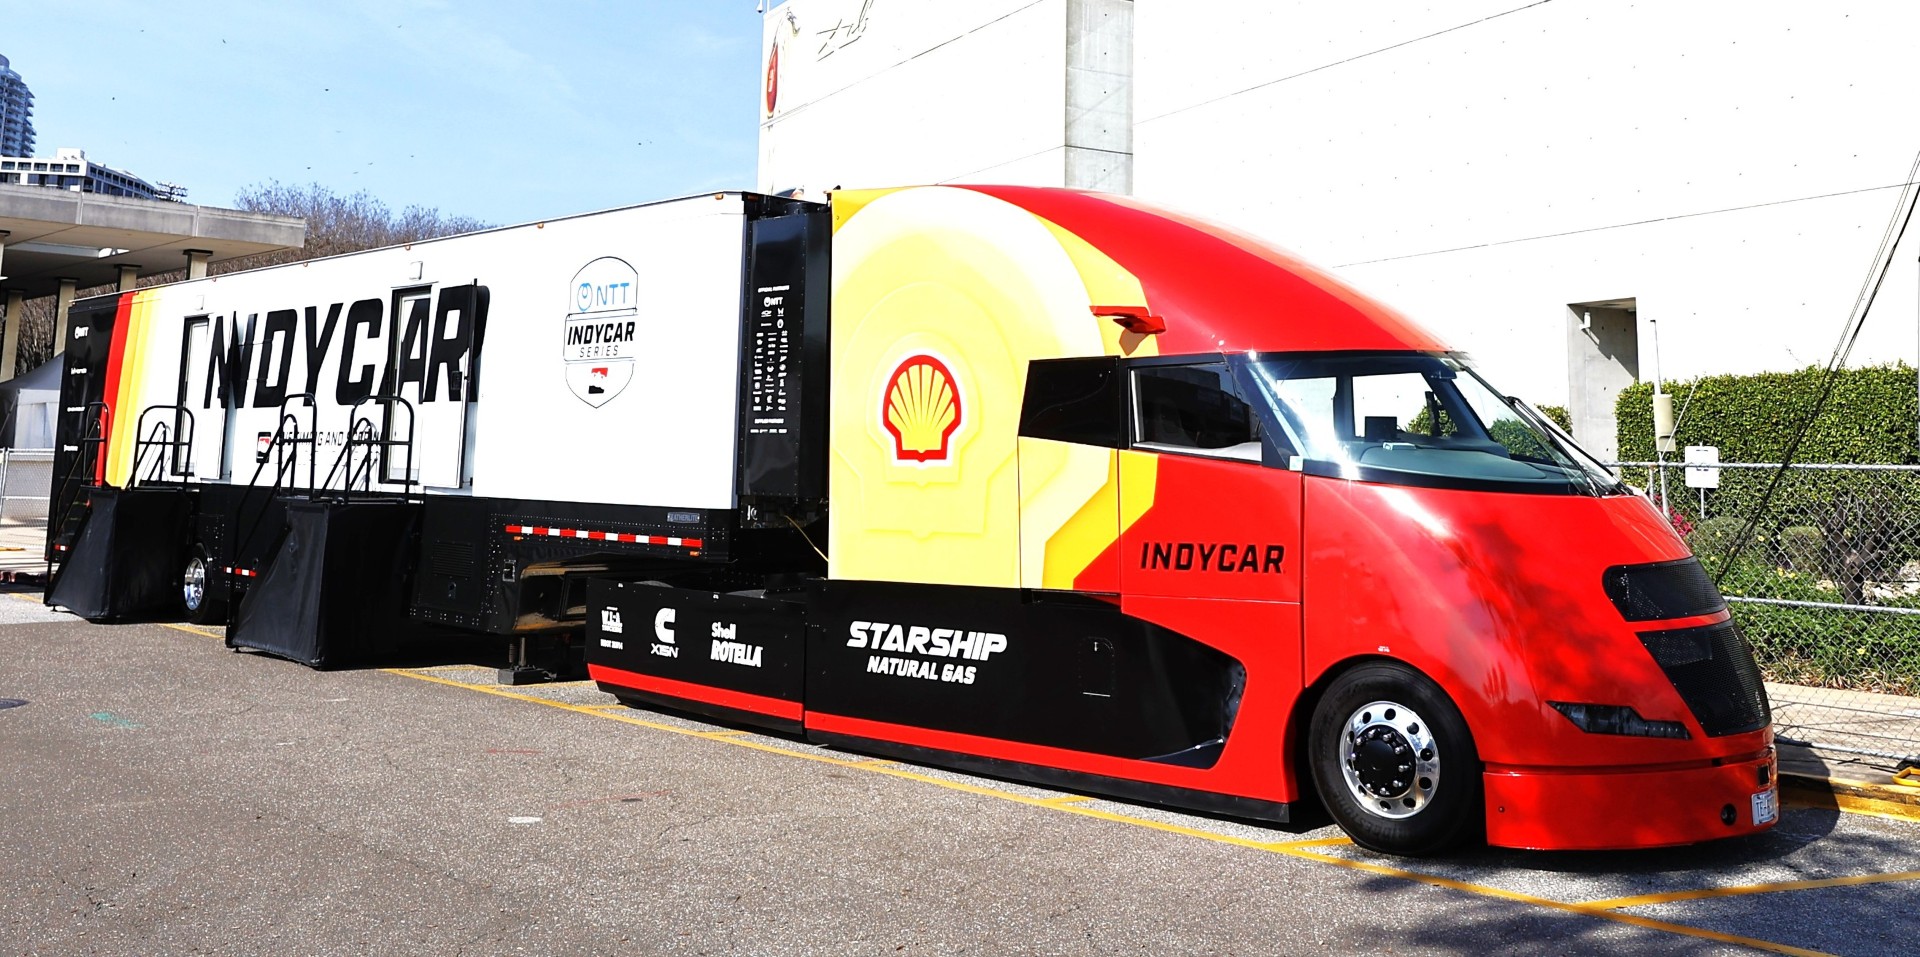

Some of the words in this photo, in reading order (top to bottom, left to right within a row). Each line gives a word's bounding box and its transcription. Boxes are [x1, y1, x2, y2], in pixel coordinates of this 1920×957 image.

[596, 282, 630, 306] NTT
[567, 321, 636, 346] INDYCAR
[579, 345, 619, 358] SERIES
[325, 431, 344, 446] AND
[1140, 542, 1285, 574] INDYCAR
[711, 621, 736, 640] Shell
[846, 620, 1008, 661] STARSHIP
[710, 639, 763, 668] ROTELLA
[866, 655, 939, 681] NATURAL
[941, 663, 977, 685] GAS
